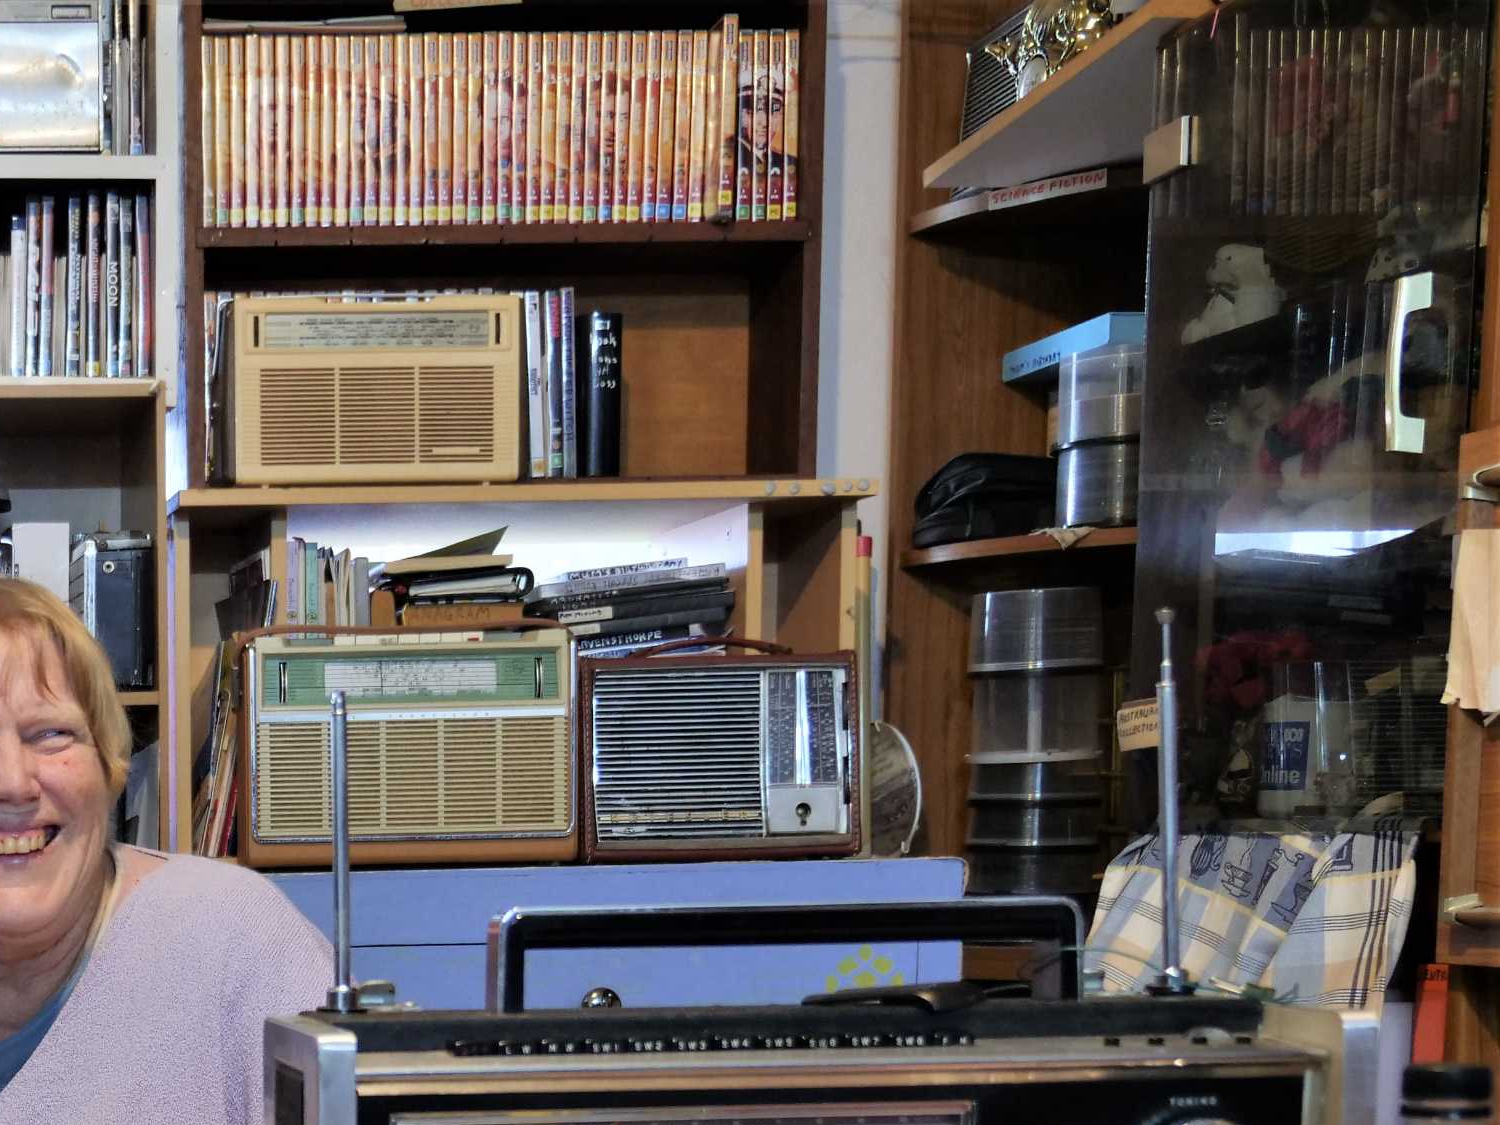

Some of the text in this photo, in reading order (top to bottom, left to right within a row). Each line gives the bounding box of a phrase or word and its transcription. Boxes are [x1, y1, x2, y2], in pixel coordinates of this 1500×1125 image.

[992, 173, 1105, 204] SCIENCE FICTION
[107, 262, 118, 307] MOON
[579, 630, 662, 650] AVENSTHORPE
